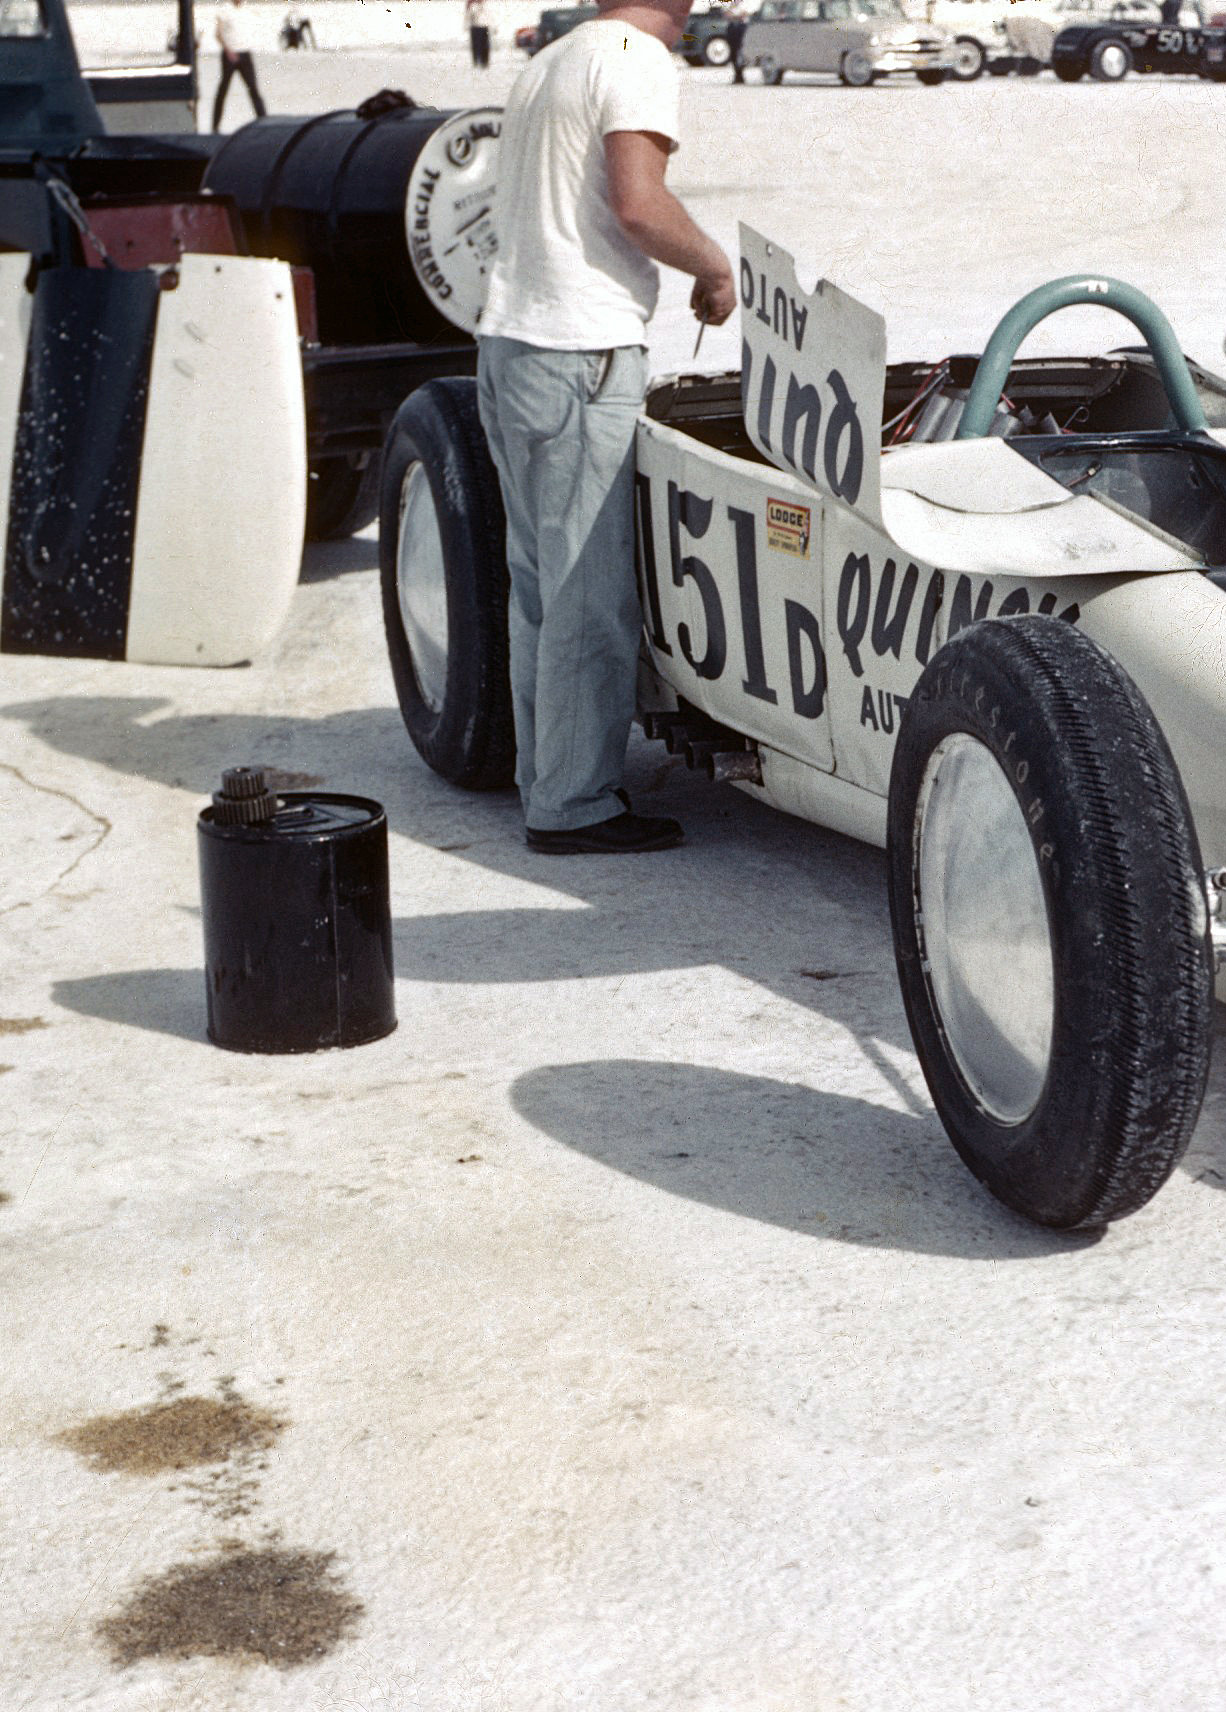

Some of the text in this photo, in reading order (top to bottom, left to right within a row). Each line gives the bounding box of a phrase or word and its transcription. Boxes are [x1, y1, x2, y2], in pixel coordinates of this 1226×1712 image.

[413, 167, 452, 299] COMMERCIAL
[741, 257, 808, 351] AUTO
[770, 506, 803, 527] LODGE
[634, 470, 828, 719] 151 D
[860, 685, 911, 735] AUT
